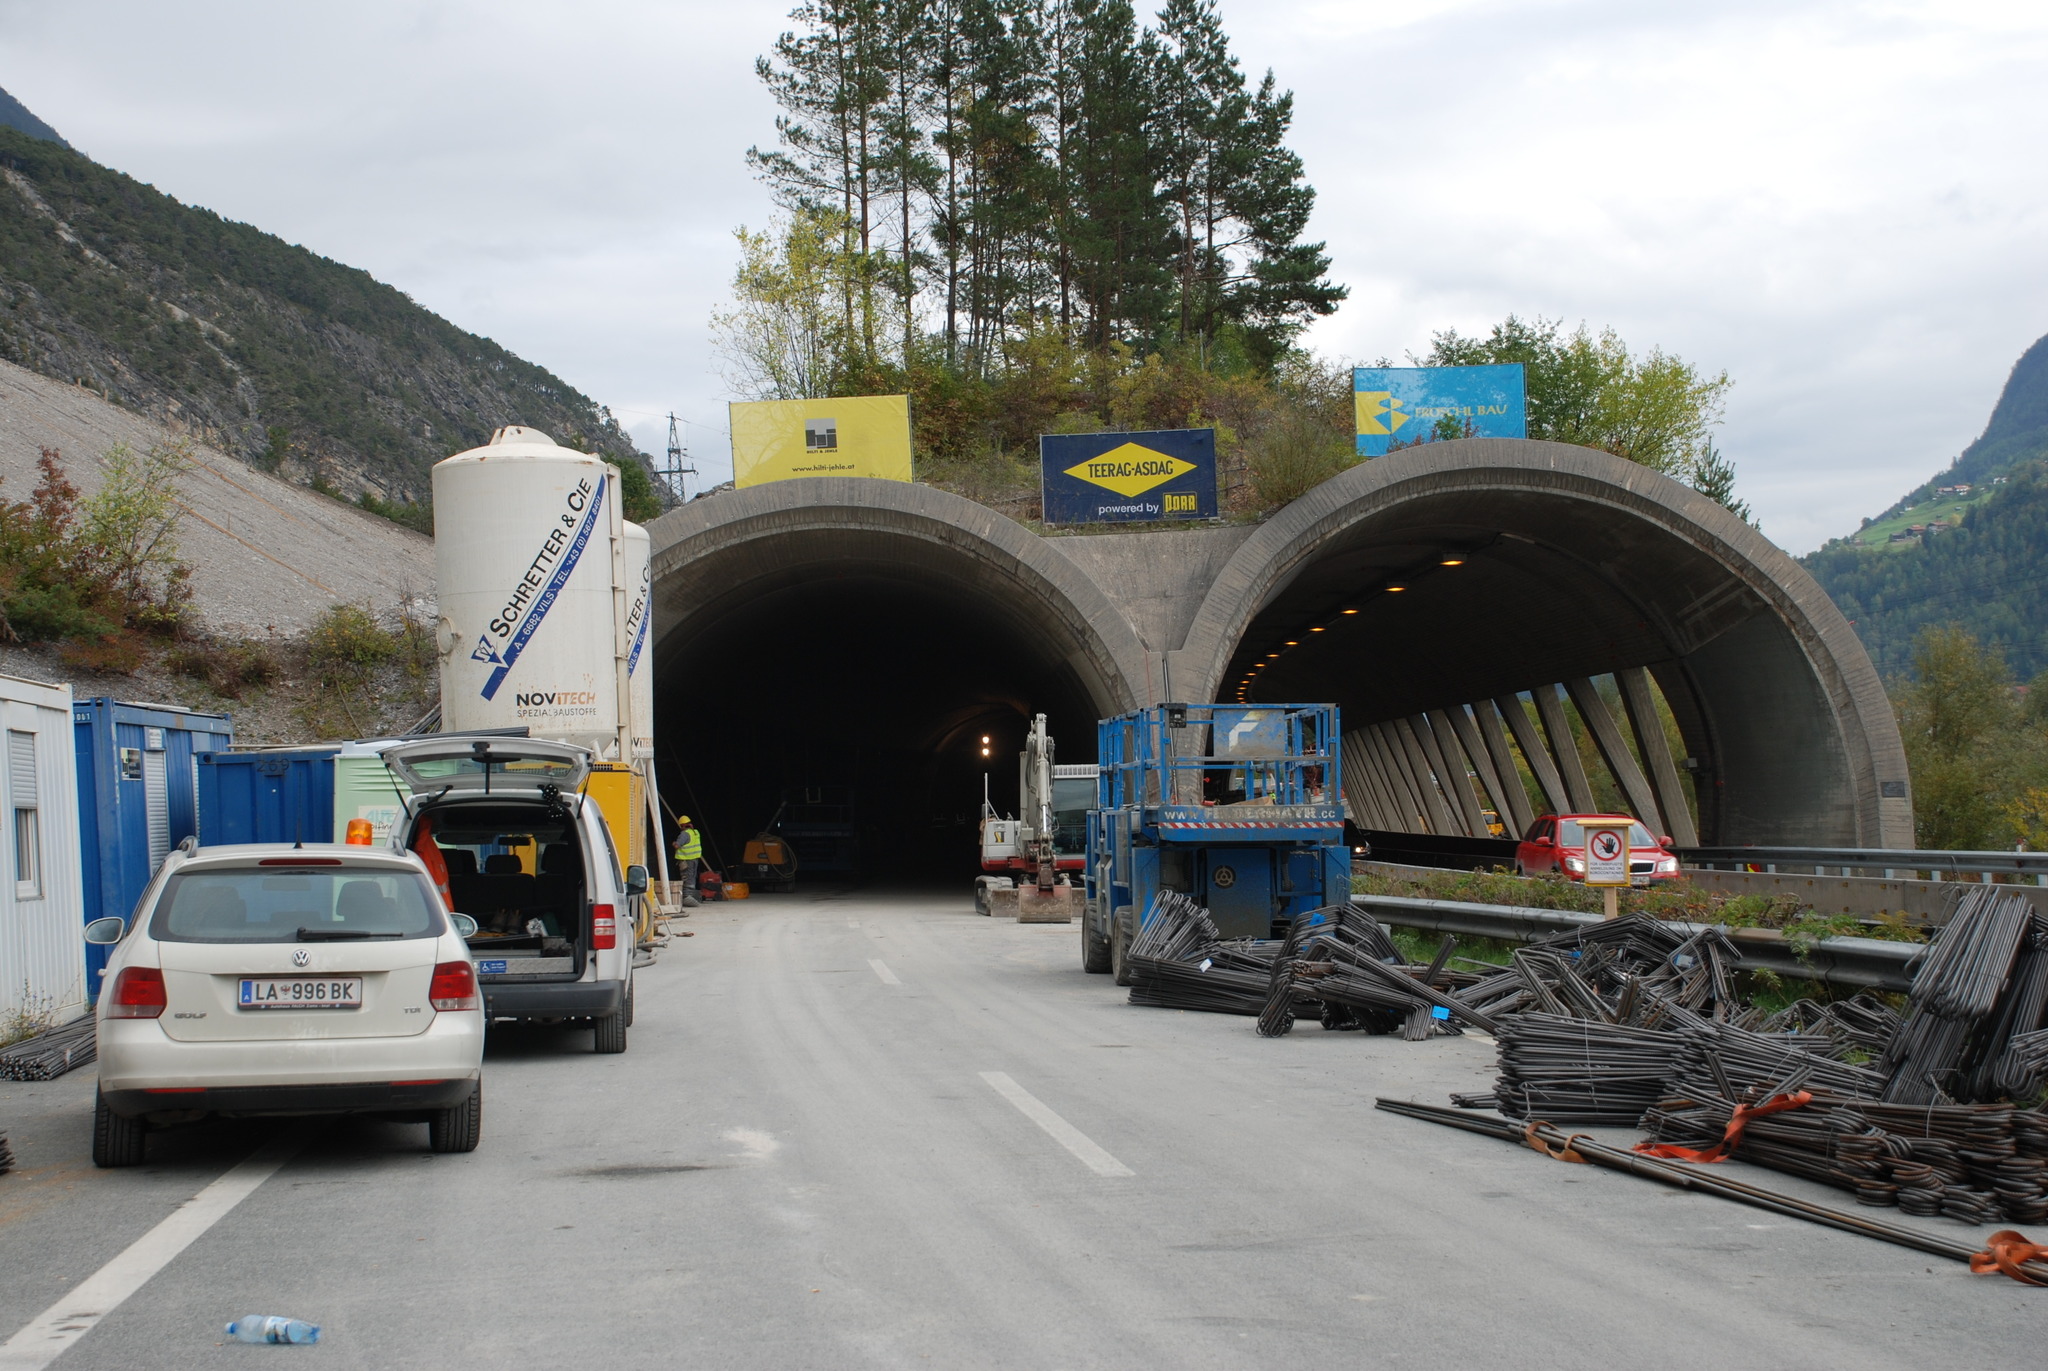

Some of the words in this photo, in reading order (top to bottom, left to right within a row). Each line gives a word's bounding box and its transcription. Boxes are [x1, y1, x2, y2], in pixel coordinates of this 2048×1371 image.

[1477, 404, 1508, 416] BAU
[792, 464, 855, 472] www.hilti-jehle.at
[1088, 460, 1174, 478] TEERAG-ASDAG
[567, 478, 592, 512] CIE
[1165, 494, 1195, 513] PORR
[1098, 503, 1144, 515] powered
[1146, 502, 1159, 514] by
[561, 514, 577, 528] &
[490, 528, 568, 638] SCHRETTER
[522, 613, 541, 636] 6682
[537, 591, 555, 613] VILS
[582, 515, 594, 537] 5677
[255, 983, 278, 1000] LA
[292, 983, 326, 999] 996
[331, 983, 353, 999] BK
